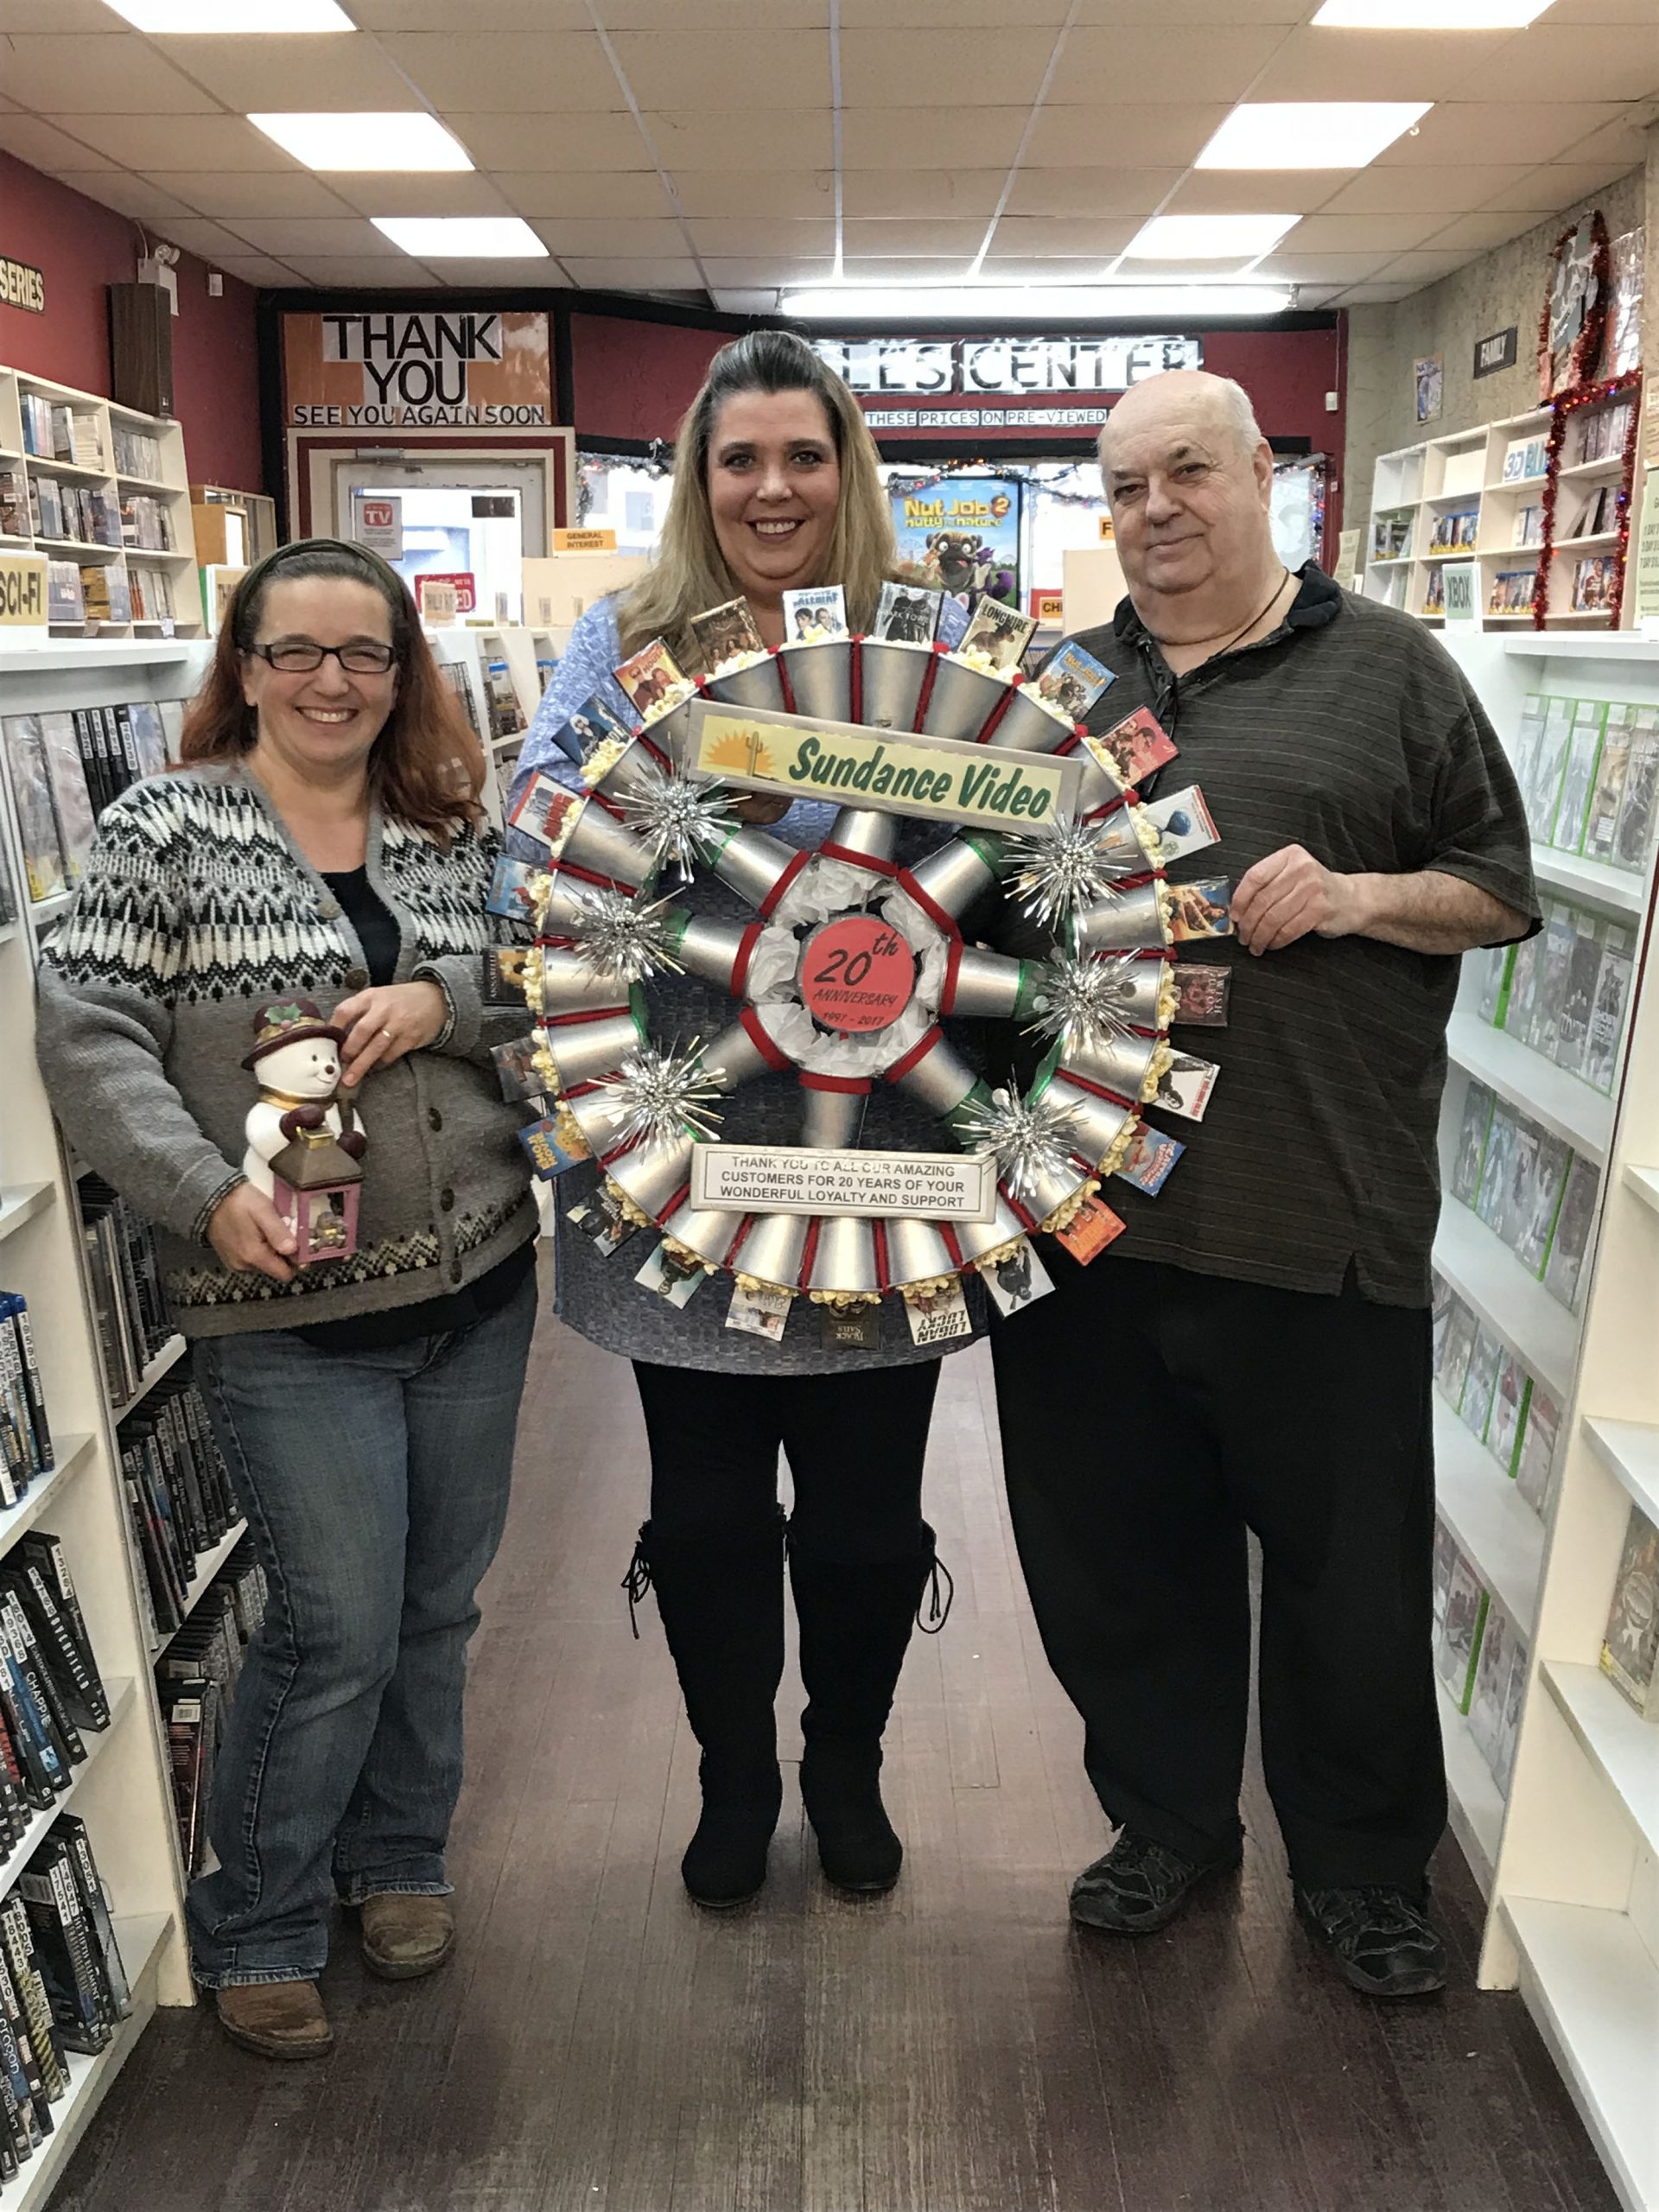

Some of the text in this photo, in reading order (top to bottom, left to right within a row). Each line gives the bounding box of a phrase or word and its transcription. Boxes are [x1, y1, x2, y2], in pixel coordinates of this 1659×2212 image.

[0, 259, 44, 311] SERIES
[322, 315, 500, 359] THANK
[364, 359, 466, 404] YOU
[294, 405, 545, 424] SEE YOU AGAIN SOON
[867, 410, 1106, 425] THESE PRICES ON PRE-VIEWED
[365, 510, 391, 524] TV
[905, 495, 1010, 517] Nut Job 2
[566, 531, 603, 540] GENERAL
[566, 540, 605, 549] INTEREST
[0, 569, 41, 615] SCI-FI
[1446, 575, 1472, 608] XBOX
[982, 603, 1028, 633] LONGMIRE
[789, 736, 1052, 819] Sundance Video
[489, 953, 499, 999] ANNABELLE
[812, 988, 898, 1007] ANNIVERSARY
[1214, 979, 1225, 1014] WISH
[823, 1011, 848, 1023] 1997
[857, 1014, 885, 1027] 2017
[721, 1170, 965, 1192] CUSTOMERS FOR 20 YEARS OF YOUR
[732, 1155, 778, 1169] THANK
[782, 1159, 809, 1171] YOU
[833, 1160, 858, 1173] ALL
[893, 1164, 955, 1177] AMAZING
[721, 1185, 965, 1208] WONDERFUL LOYALTY AND SUPPORT
[836, 1331, 864, 1342] BLACK
[917, 1309, 966, 1332] LUCKY
[917, 1320, 967, 1344] LOGAN
[3, 1608, 27, 1660] 19368
[26, 1671, 53, 1727] CHAPPIE
[77, 1840, 96, 1892] 13051
[52, 1870, 69, 1924] 17541
[60, 1859, 79, 1915] 14647
[5, 1913, 24, 1969] 18443
[13, 1900, 32, 1955] 18005
[85, 1960, 99, 2001] ELEMENT
[0, 2016, 21, 2075] eragon
